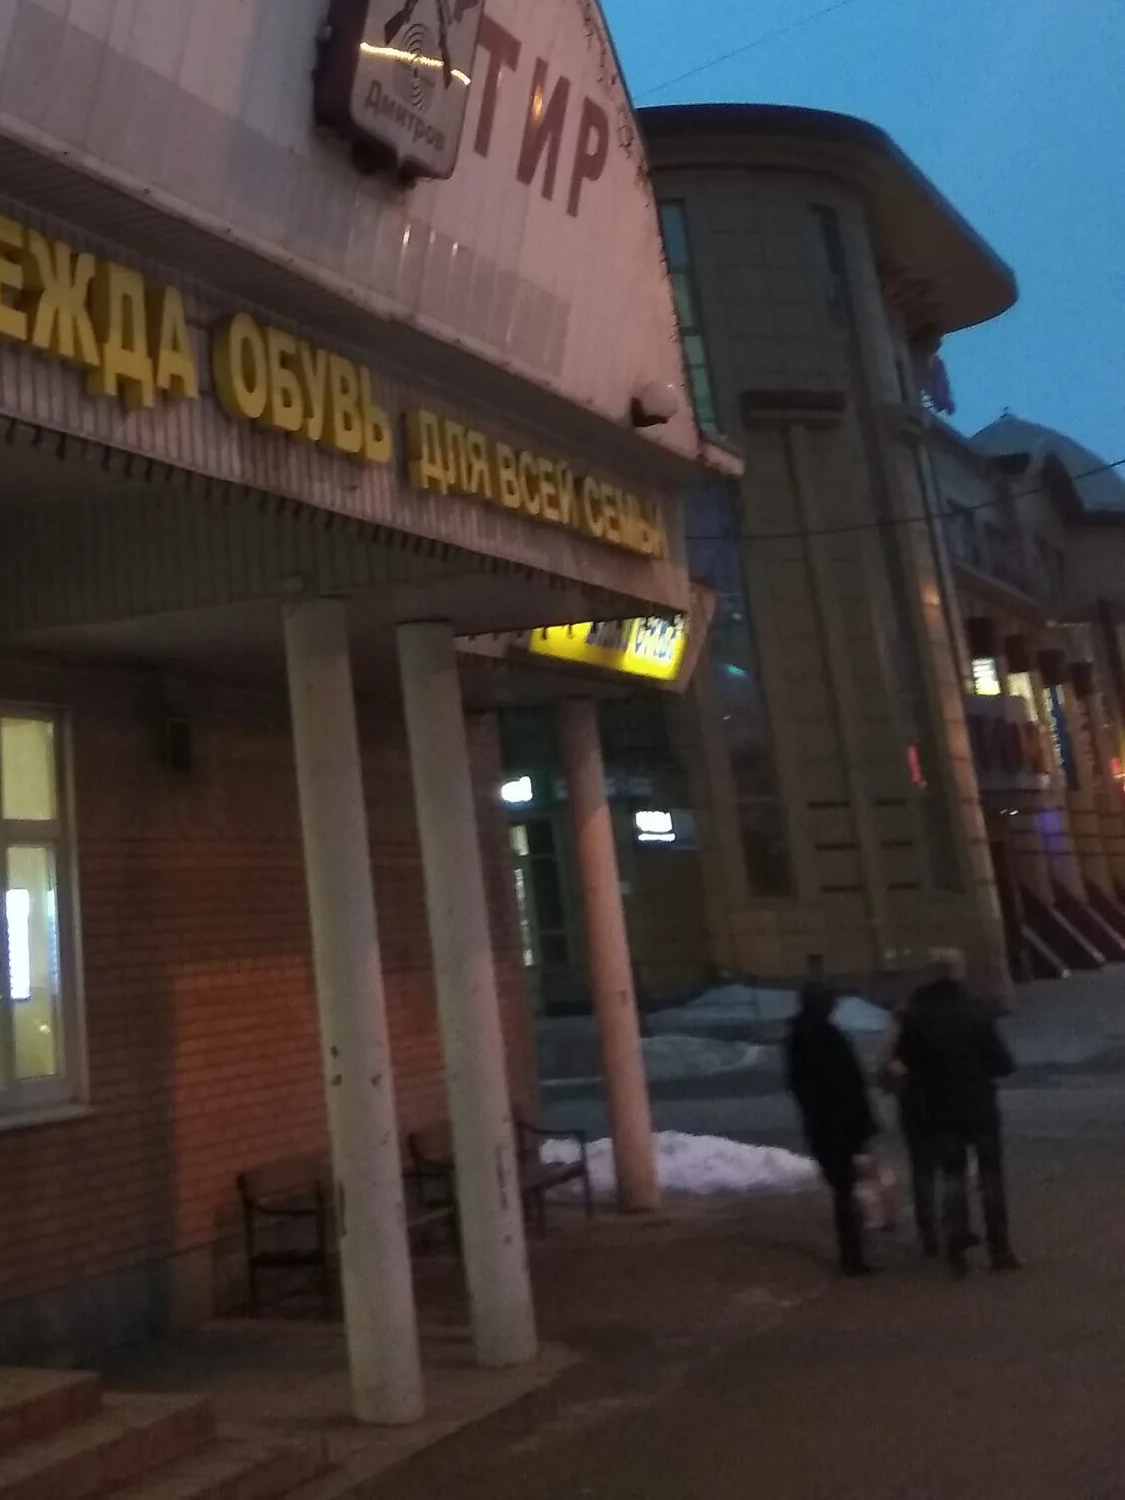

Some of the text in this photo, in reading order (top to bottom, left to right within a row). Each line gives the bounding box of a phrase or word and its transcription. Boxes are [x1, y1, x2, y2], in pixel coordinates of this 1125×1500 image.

[364, 79, 446, 152] Дмитров
[474, 11, 610, 218] ТИР
[225, 312, 393, 464] ОБУВЬ
[416, 408, 493, 499] ДЛЯ
[496, 441, 573, 525] ВСЕЙ
